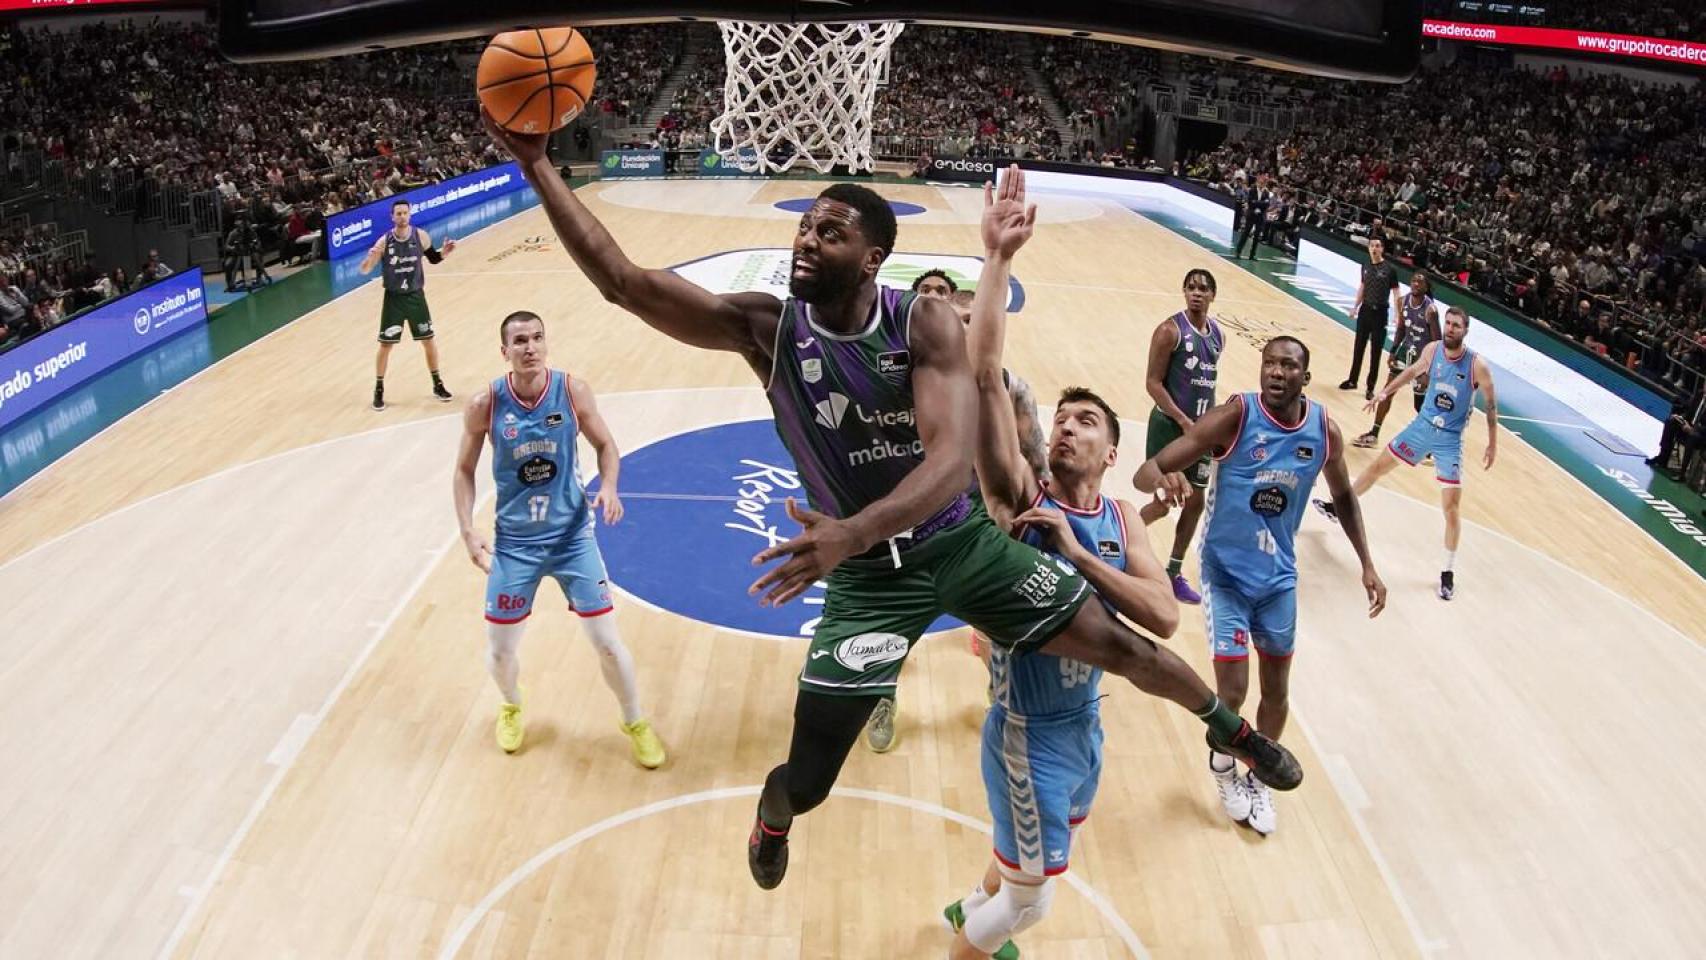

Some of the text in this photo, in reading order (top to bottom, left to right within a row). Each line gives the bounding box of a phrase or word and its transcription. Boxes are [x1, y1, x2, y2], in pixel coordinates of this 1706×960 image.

[935, 159, 993, 173] endesa
[400, 278, 409, 291] 4
[151, 287, 201, 318] instituto hm
[34, 341, 87, 383] superior
[1196, 398, 1209, 417] 11
[528, 495, 550, 521] 17
